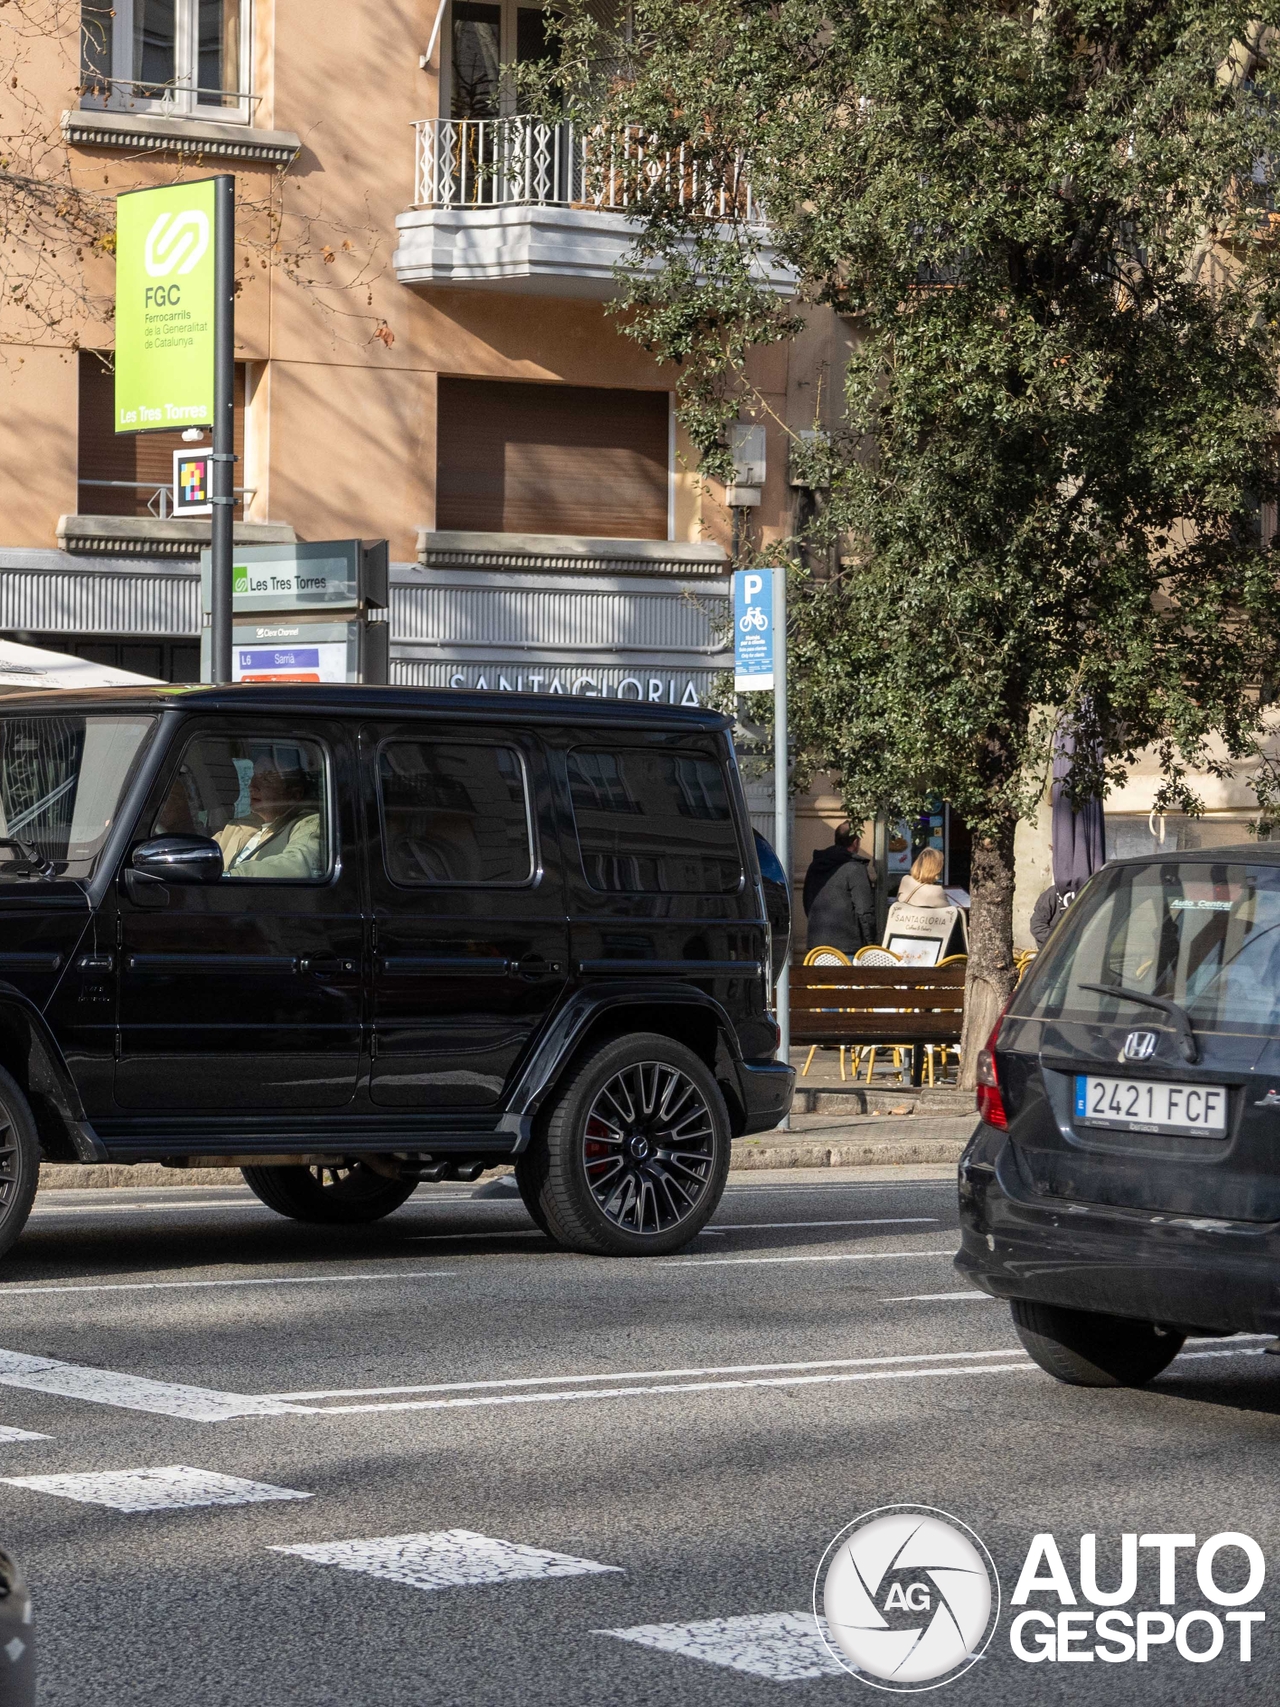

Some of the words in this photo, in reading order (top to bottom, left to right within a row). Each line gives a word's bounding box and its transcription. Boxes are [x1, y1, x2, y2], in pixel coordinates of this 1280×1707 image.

[145, 284, 181, 309] FGC
[145, 310, 191, 324] Ferrocarrils
[145, 325, 153, 336] de
[155, 324, 162, 335] la
[162, 322, 208, 335] Generalitat
[145, 339, 153, 350] de
[154, 336, 194, 349] Catalunya
[120, 408, 137, 424] Les
[139, 406, 162, 422] Tres
[164, 404, 208, 420] Torres
[249, 577, 268, 591] Les
[270, 576, 292, 590] Tres
[294, 575, 327, 590] Torres
[744, 574, 763, 605] P
[241, 655, 252, 666] L6
[274, 653, 295, 665] Sarrià
[895, 914, 947, 925] SANTAGLORIA
[1092, 1082, 1154, 1118] 2421
[1167, 1088, 1221, 1123] FCF
